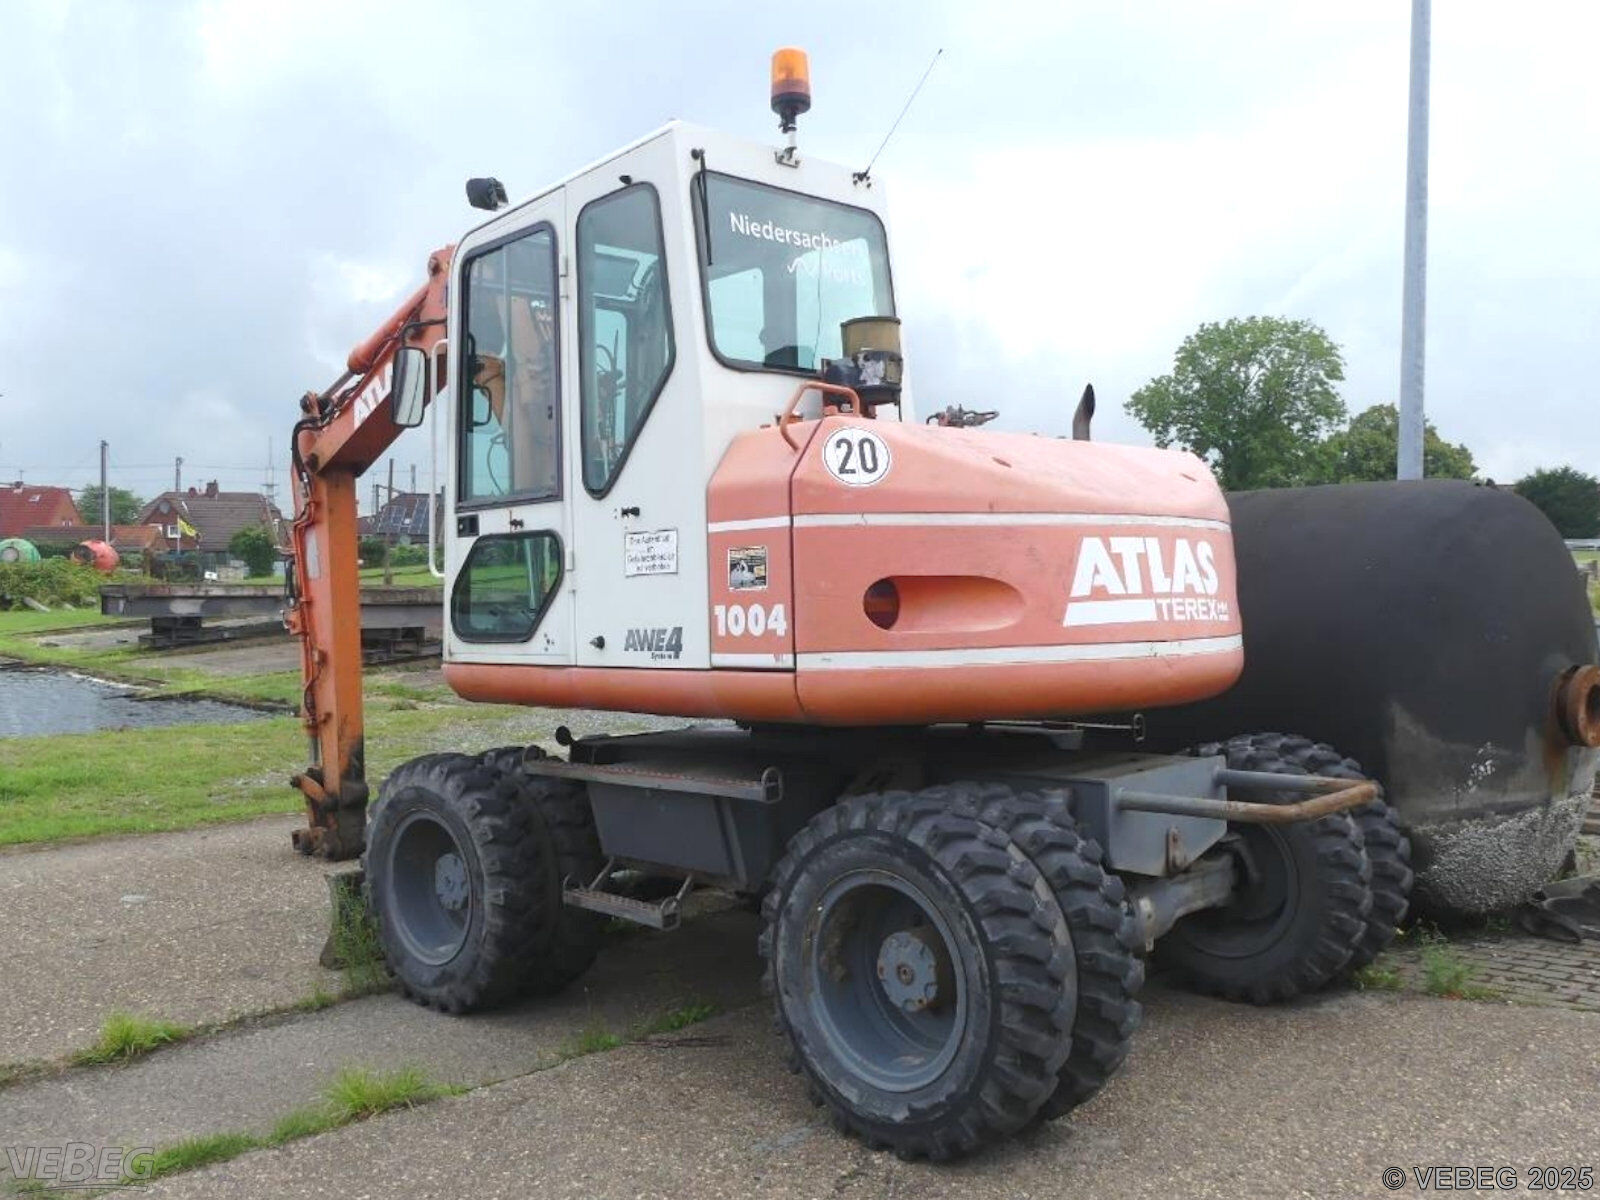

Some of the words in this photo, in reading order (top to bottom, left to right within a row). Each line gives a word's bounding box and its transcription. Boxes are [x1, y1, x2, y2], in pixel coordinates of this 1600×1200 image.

[835, 437, 878, 474] 20
[1069, 536, 1219, 596] ATLAS
[714, 603, 787, 637] 1004
[1156, 598, 1218, 622] TEREX
